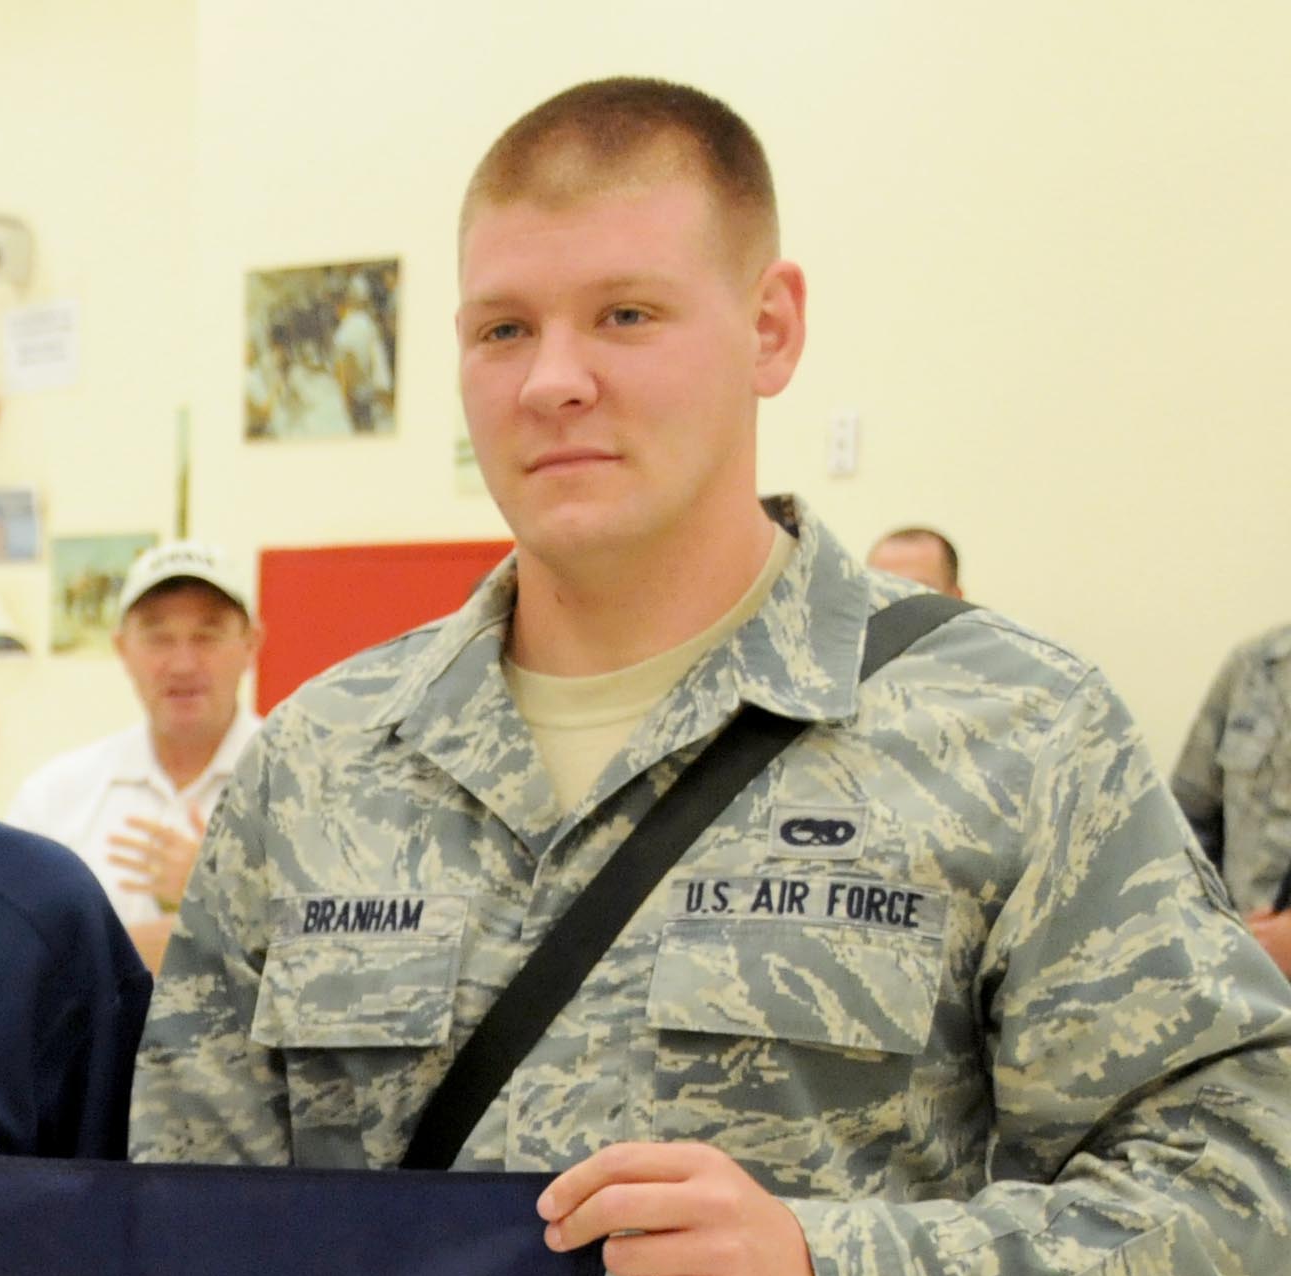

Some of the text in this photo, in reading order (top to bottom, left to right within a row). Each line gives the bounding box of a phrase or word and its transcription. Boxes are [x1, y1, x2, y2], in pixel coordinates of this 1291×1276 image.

[303, 898, 425, 933] BRANHAM
[686, 880, 924, 928] U.S. AIR FORCE
